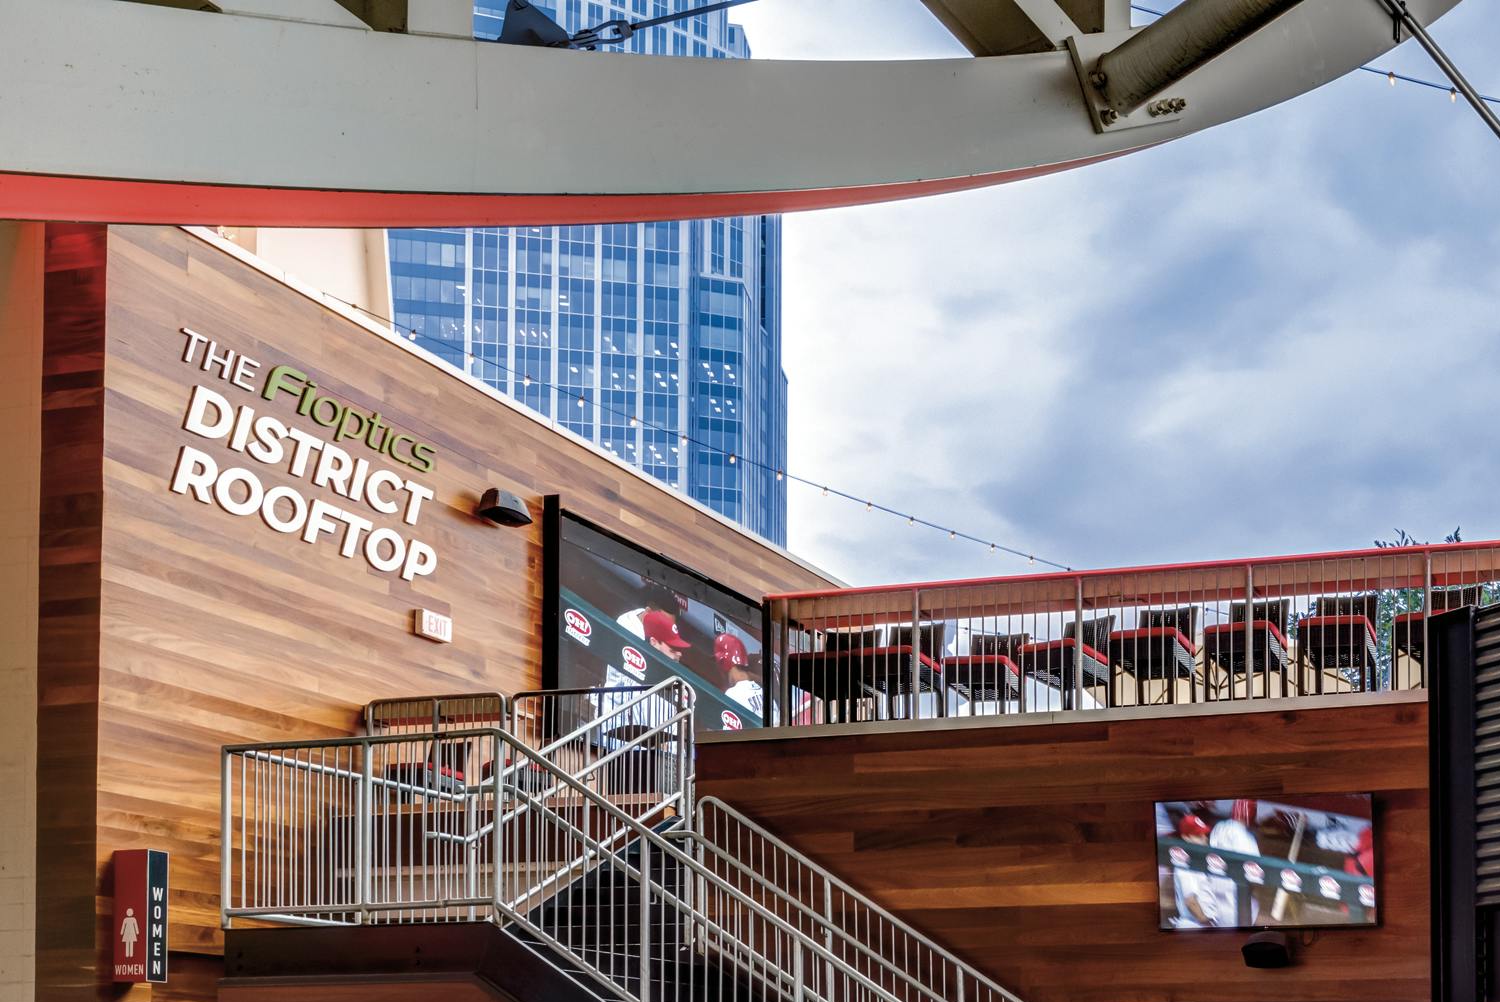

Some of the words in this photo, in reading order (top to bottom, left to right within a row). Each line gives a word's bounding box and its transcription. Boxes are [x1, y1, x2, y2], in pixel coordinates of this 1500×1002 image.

[180, 327, 261, 391] THE
[261, 365, 437, 473] Fioptics
[182, 384, 434, 525] DISTRICT
[170, 445, 437, 581] ROOFTOP
[428, 614, 447, 638] EXIT
[115, 964, 144, 976] WOMEN
[152, 887, 163, 975] WOMEN
